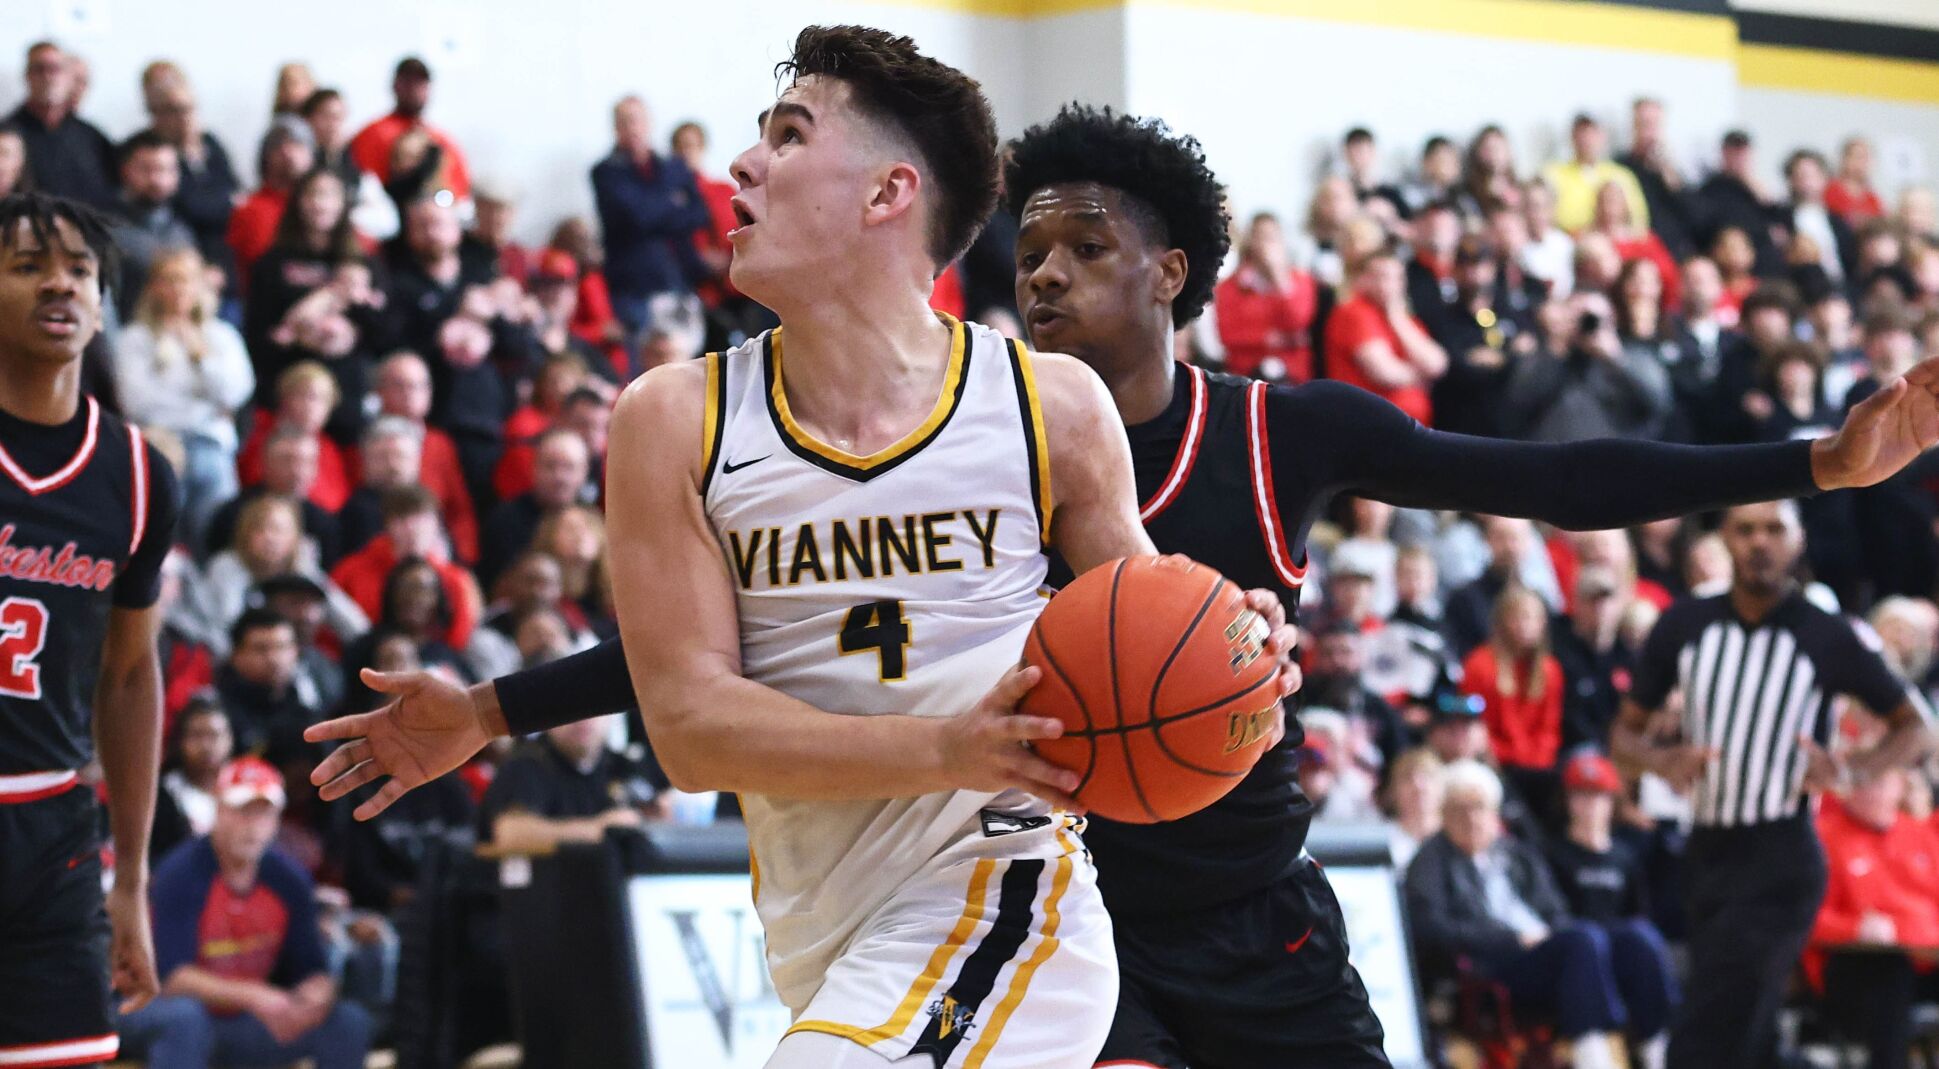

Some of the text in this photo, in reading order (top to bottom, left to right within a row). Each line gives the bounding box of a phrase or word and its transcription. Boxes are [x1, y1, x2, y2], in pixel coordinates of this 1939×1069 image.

[727, 508, 1001, 590] VIANNEY
[0, 596, 49, 700] 2
[837, 600, 913, 683] 4
